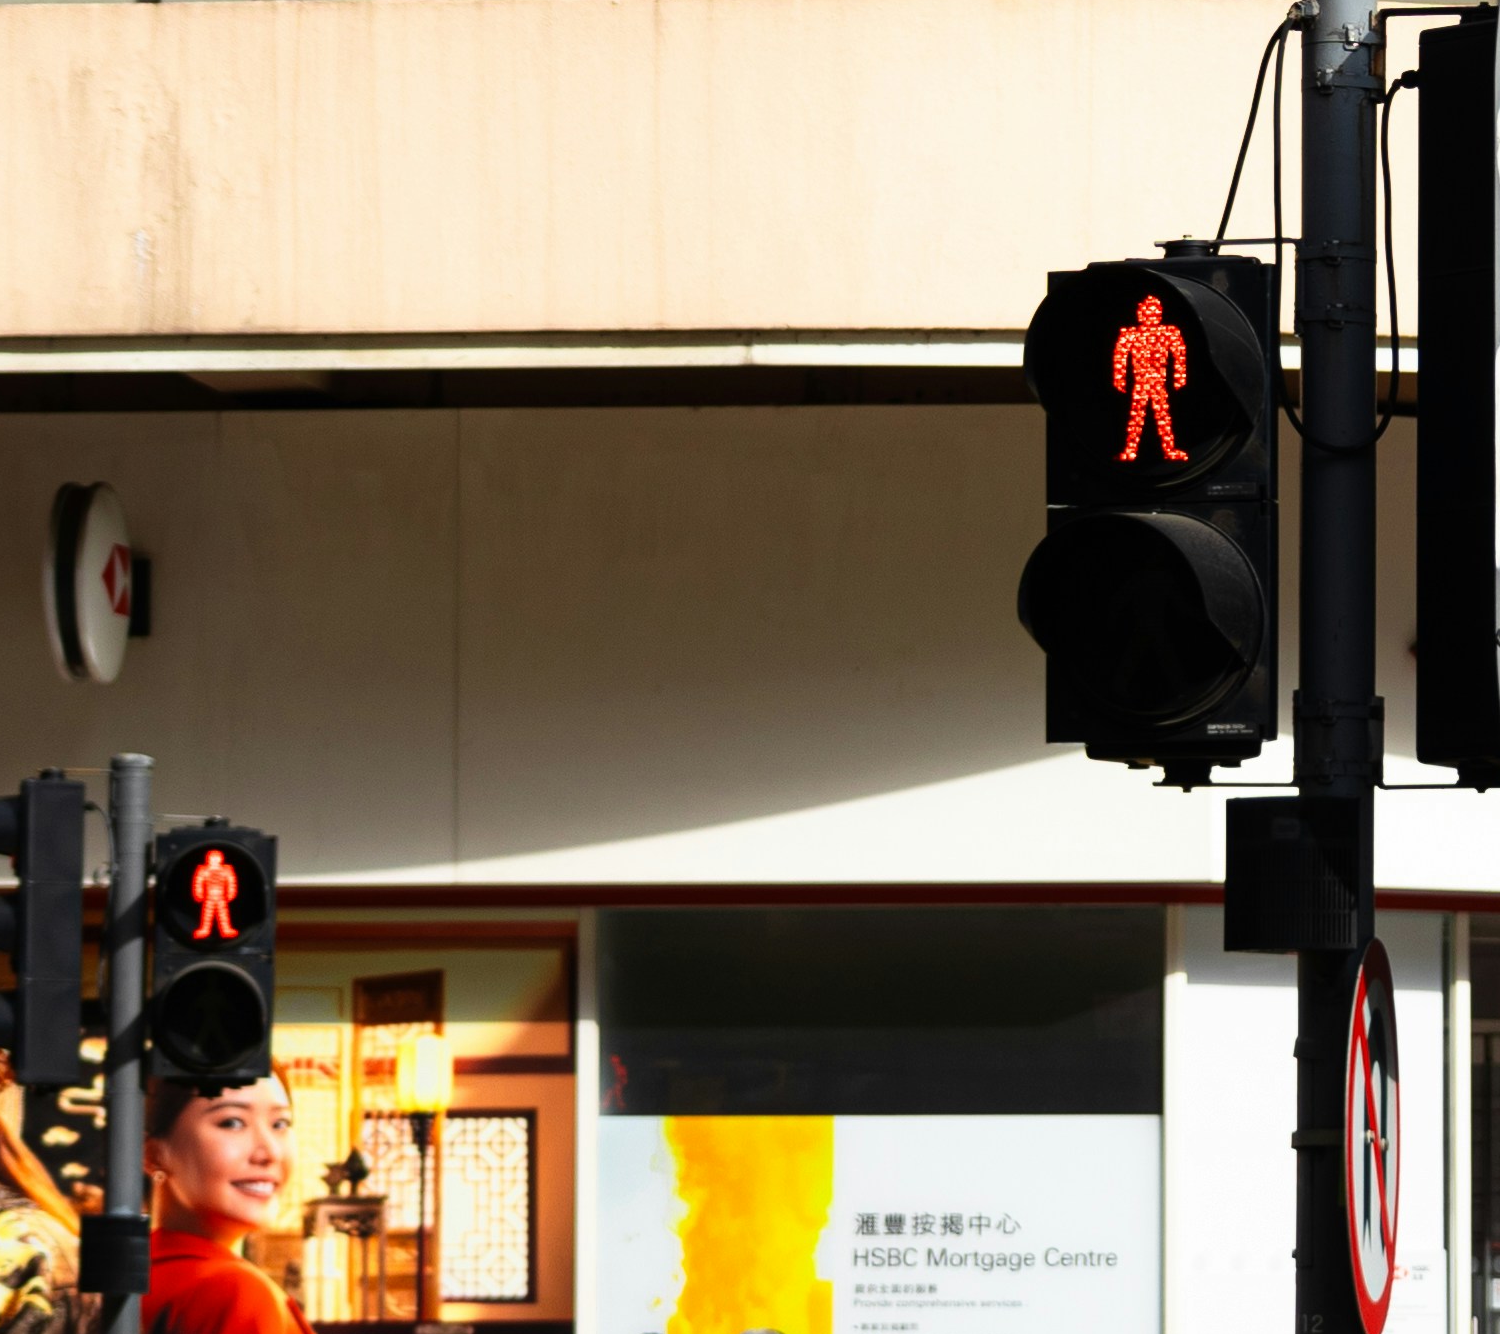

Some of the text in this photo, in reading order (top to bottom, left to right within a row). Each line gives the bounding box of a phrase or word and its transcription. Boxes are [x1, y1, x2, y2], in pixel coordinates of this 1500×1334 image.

[853, 1247, 1118, 1272] HSBC Mortgage Centre
